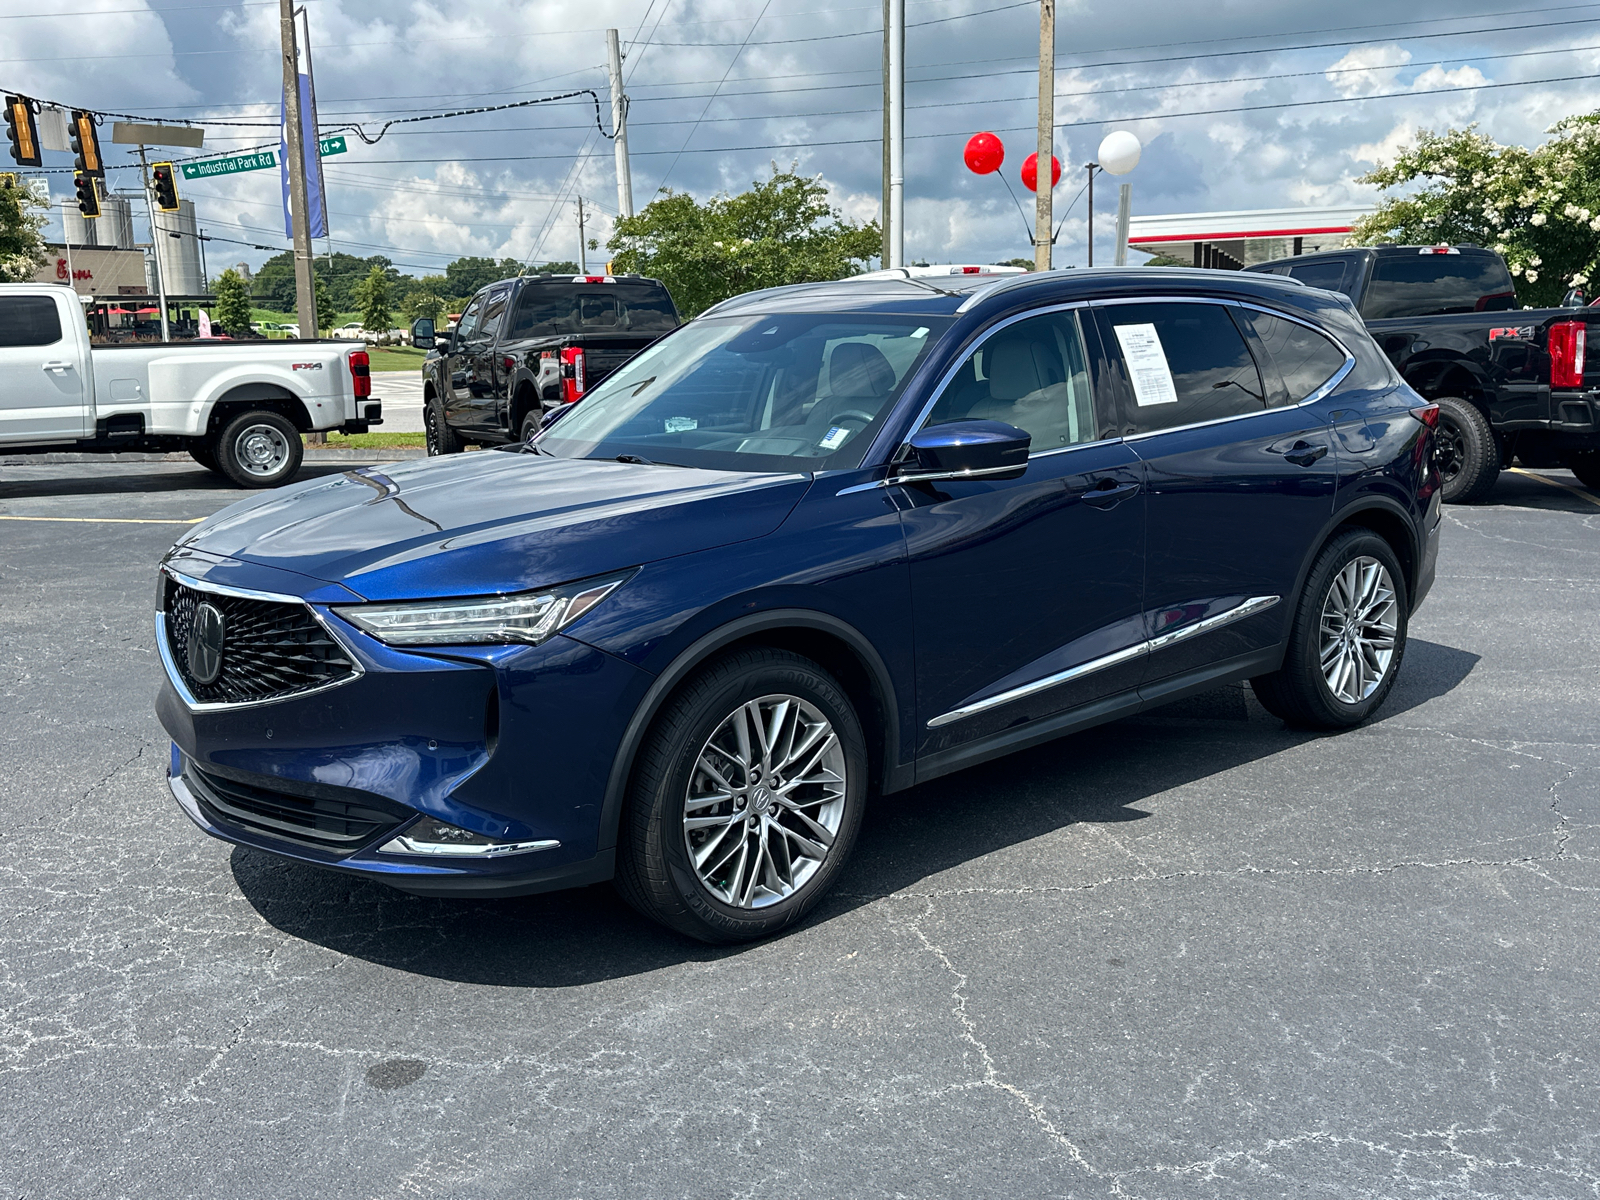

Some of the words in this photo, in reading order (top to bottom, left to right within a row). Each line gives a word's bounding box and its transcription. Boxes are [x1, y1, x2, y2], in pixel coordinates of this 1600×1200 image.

[198, 159, 237, 175] Industrial
[237, 157, 258, 170] Park
[259, 154, 272, 166] Rd
[1489, 326, 1535, 341] FX4
[292, 362, 322, 371] FX4
[776, 671, 852, 722] GOODYEAR
